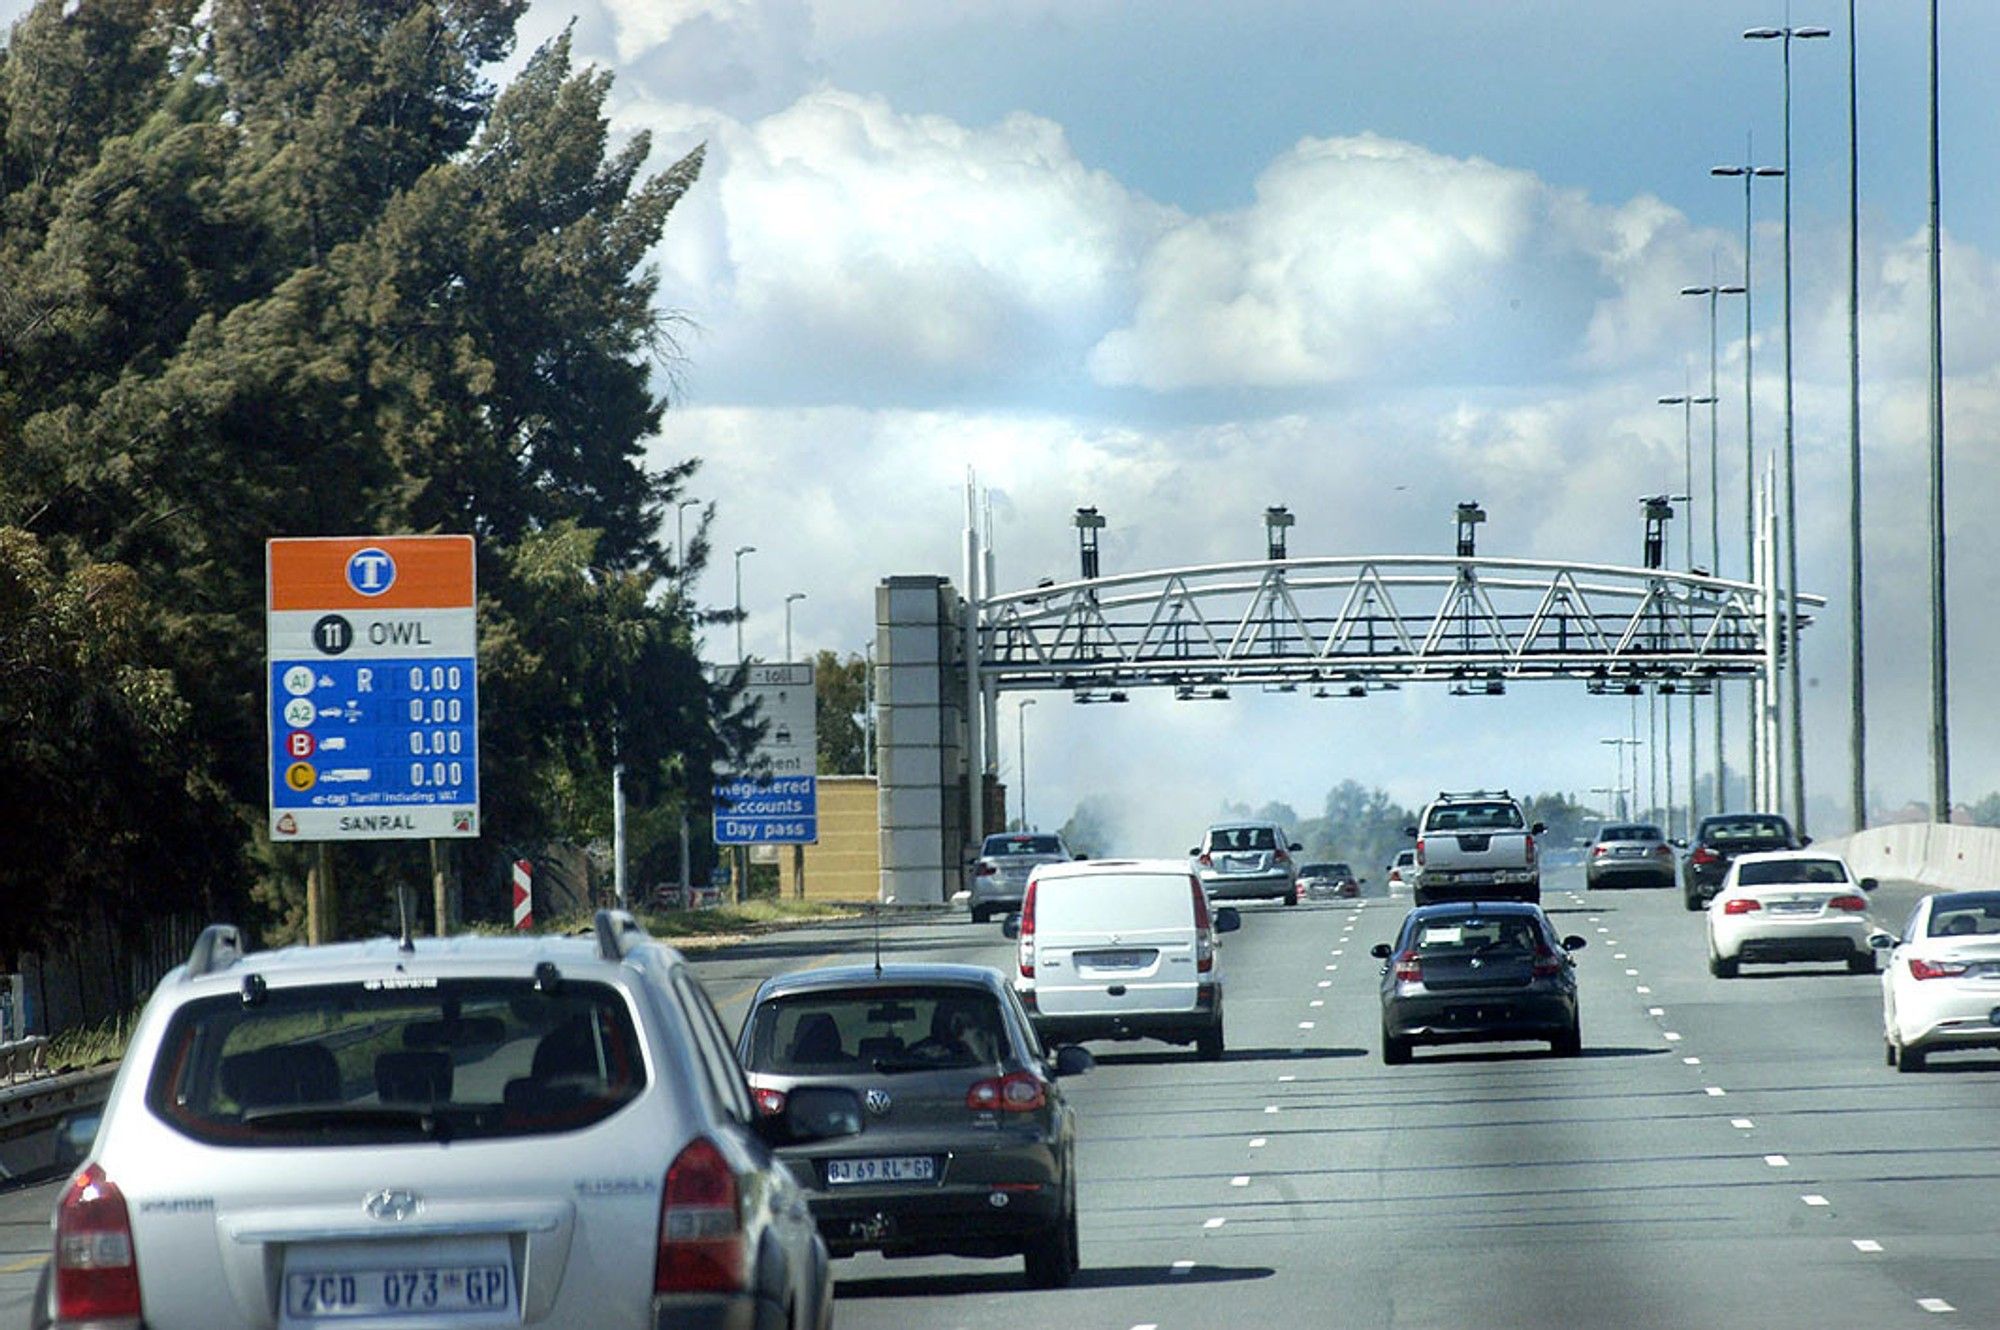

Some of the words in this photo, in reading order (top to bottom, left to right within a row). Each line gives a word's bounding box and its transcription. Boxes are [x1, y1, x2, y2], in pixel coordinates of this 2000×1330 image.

[355, 556, 388, 588] T
[322, 624, 344, 648] 11
[369, 622, 431, 645] OWL
[357, 668, 373, 692] R
[410, 667, 461, 692] 0.00
[288, 705, 311, 721] A2
[410, 699, 461, 724] 0.00
[292, 734, 310, 756] B
[410, 731, 462, 755] 0.00
[291, 768, 309, 788] C
[411, 762, 462, 787] 0.00
[339, 814, 416, 832] SANRAL
[726, 821, 758, 840] Day
[765, 822, 805, 839] pass
[383, 1271, 439, 1309] 073
[466, 1268, 501, 1305] GP
